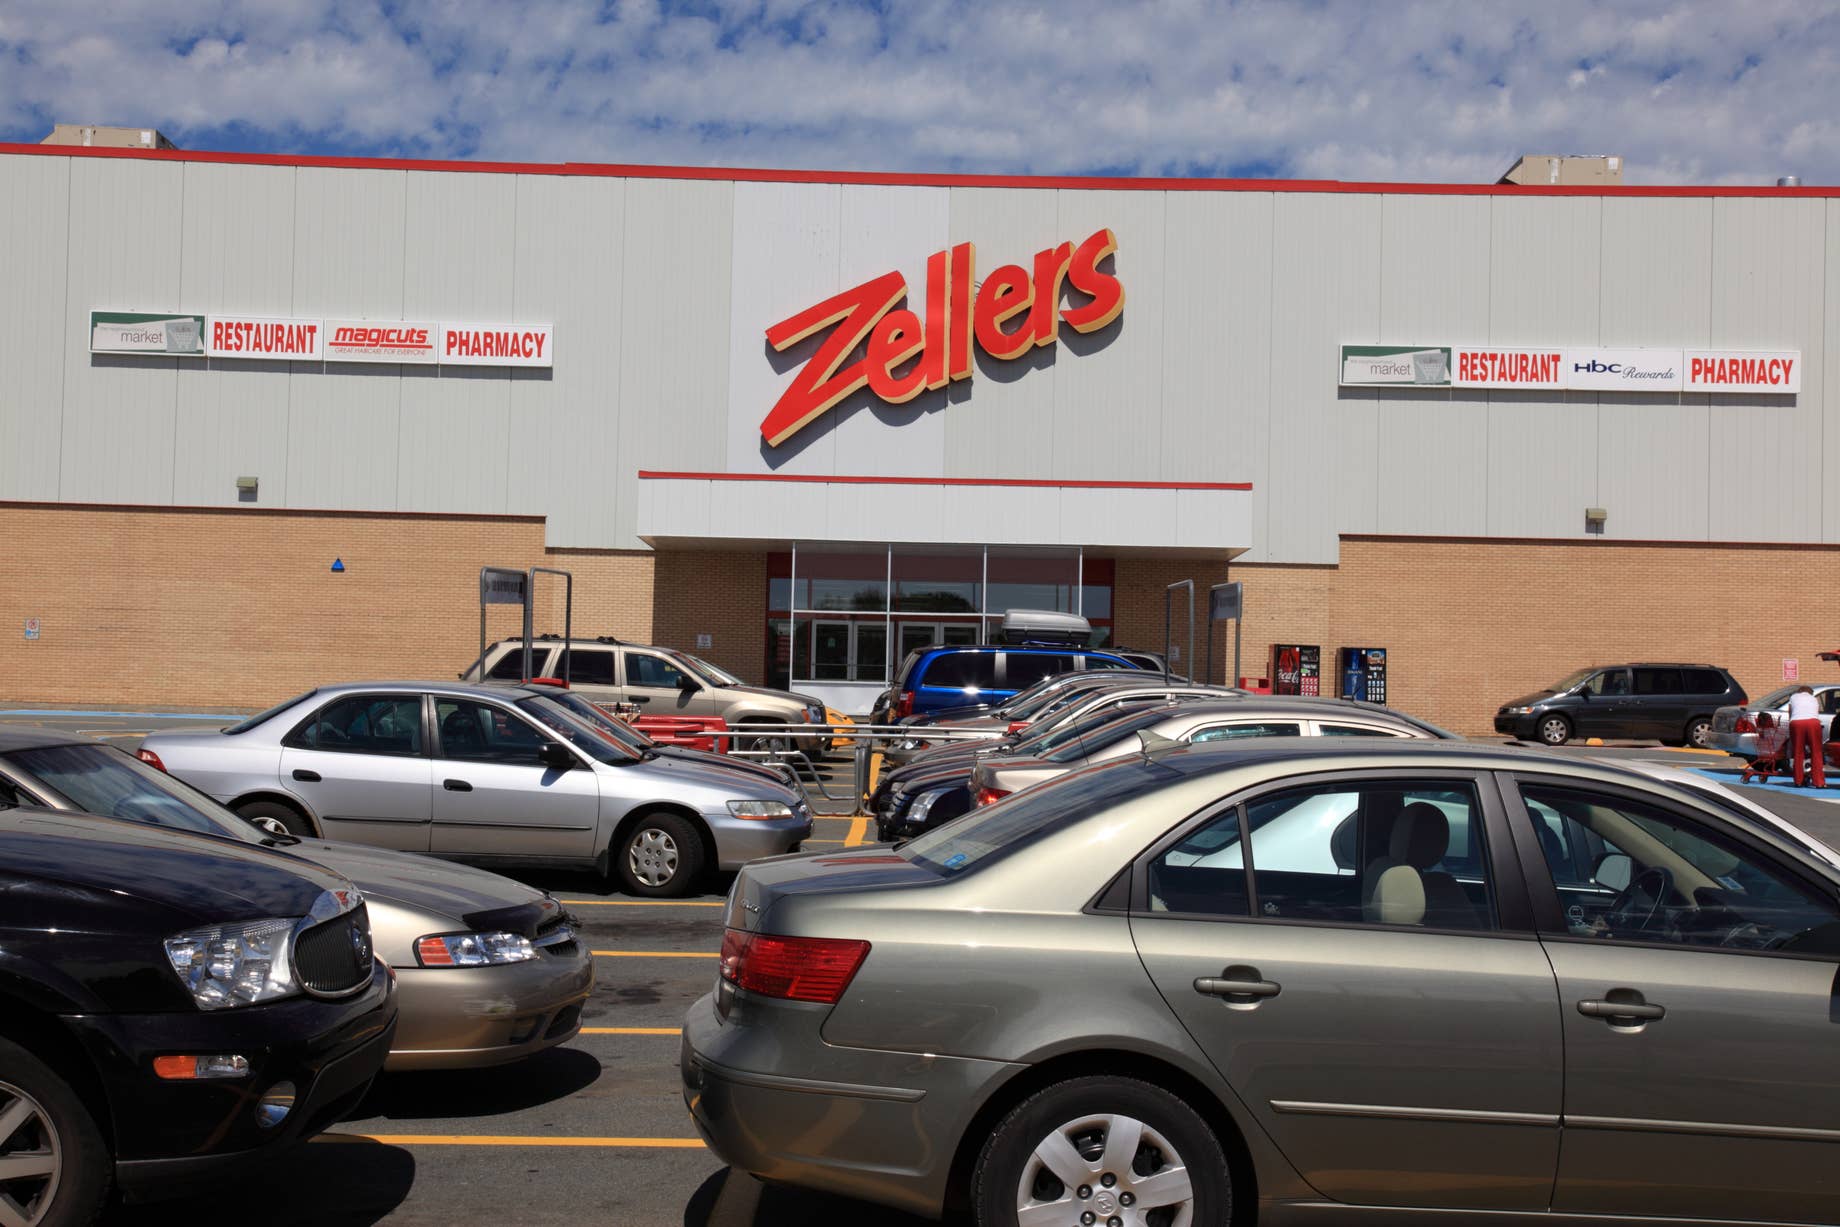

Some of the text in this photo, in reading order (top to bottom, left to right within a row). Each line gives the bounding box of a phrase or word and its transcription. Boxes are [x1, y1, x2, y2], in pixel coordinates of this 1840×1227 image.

[121, 331, 163, 344] market
[213, 321, 317, 353] RESTAURANT
[334, 327, 428, 347] magicuts
[446, 330, 546, 358] PHARMACY
[760, 228, 1125, 447] Zellers
[1370, 363, 1411, 375] market
[1459, 352, 1561, 383] RESTAURANT
[1574, 360, 1675, 379] Hbc Rewards
[1691, 357, 1794, 385] PHARMACY
